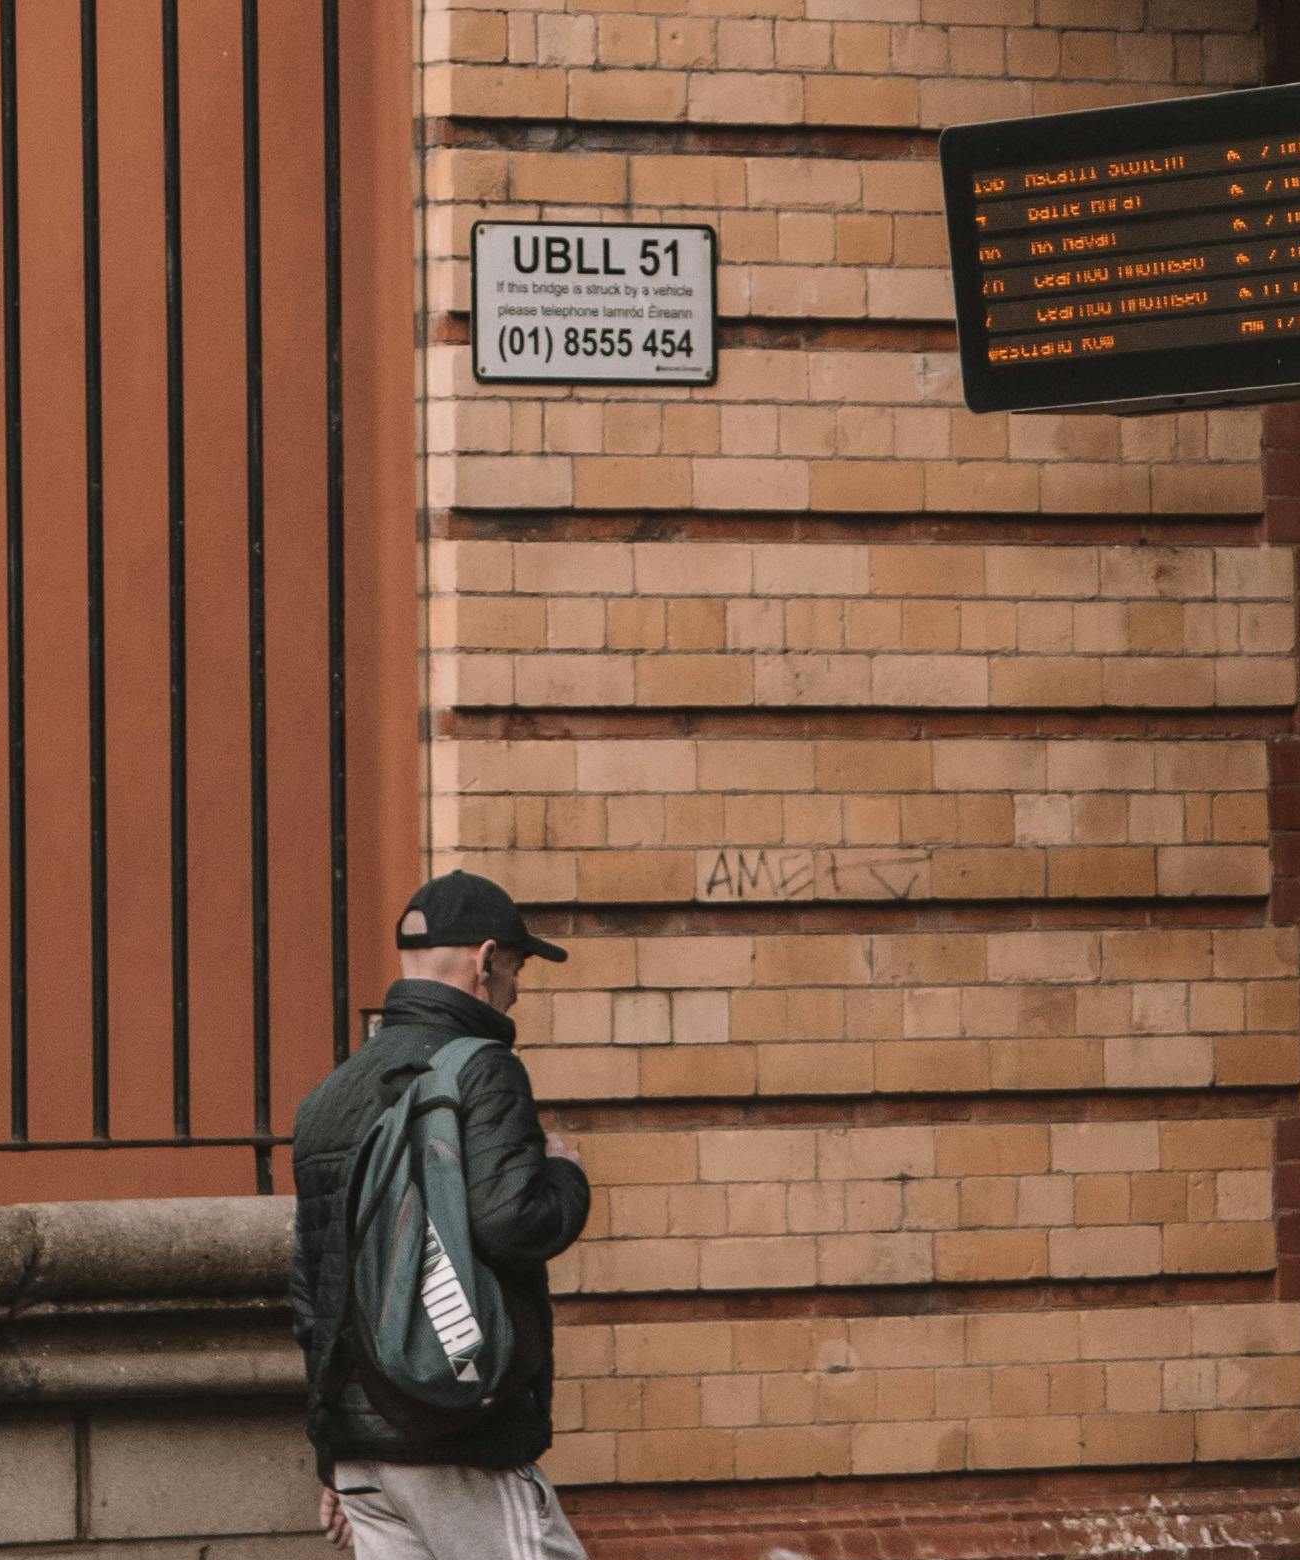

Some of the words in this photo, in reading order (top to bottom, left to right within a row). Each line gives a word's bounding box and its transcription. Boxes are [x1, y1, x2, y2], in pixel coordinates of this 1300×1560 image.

[513, 236, 626, 276] UBLL
[639, 239, 679, 276] 51
[496, 281, 504, 293] If
[507, 282, 528, 293] this
[532, 282, 568, 296] bridge
[573, 283, 582, 294] is
[585, 283, 621, 295] struck
[625, 284, 638, 297] by
[642, 286, 649, 295] a
[652, 284, 693, 296] vehicle
[498, 305, 538, 318] please
[541, 306, 599, 319] telephone
[498, 325, 554, 363] (01)
[564, 327, 633, 357] 8555
[642, 329, 693, 358] 454
